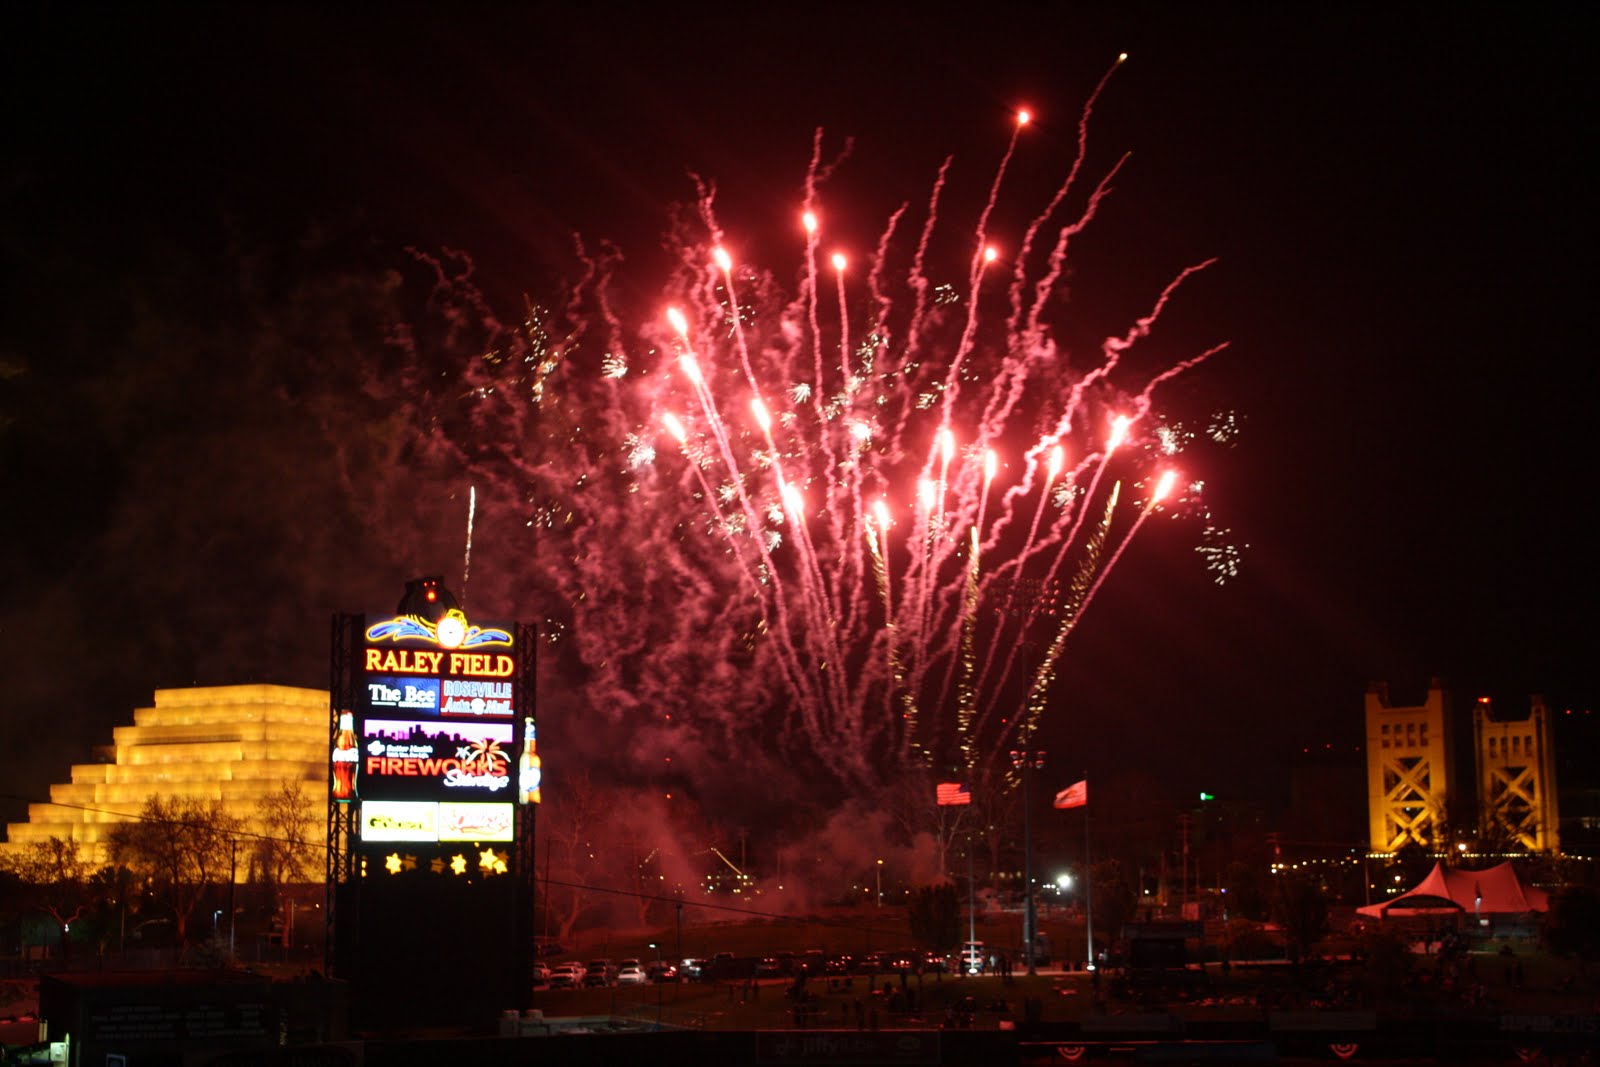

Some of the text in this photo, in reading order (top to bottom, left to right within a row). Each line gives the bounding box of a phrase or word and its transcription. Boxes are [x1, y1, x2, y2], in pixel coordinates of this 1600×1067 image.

[365, 648, 514, 677] RALEY FIELD
[368, 684, 436, 702] The Bee
[443, 680, 512, 699] ROSEVILLE
[367, 757, 507, 777] FIREWORKS
